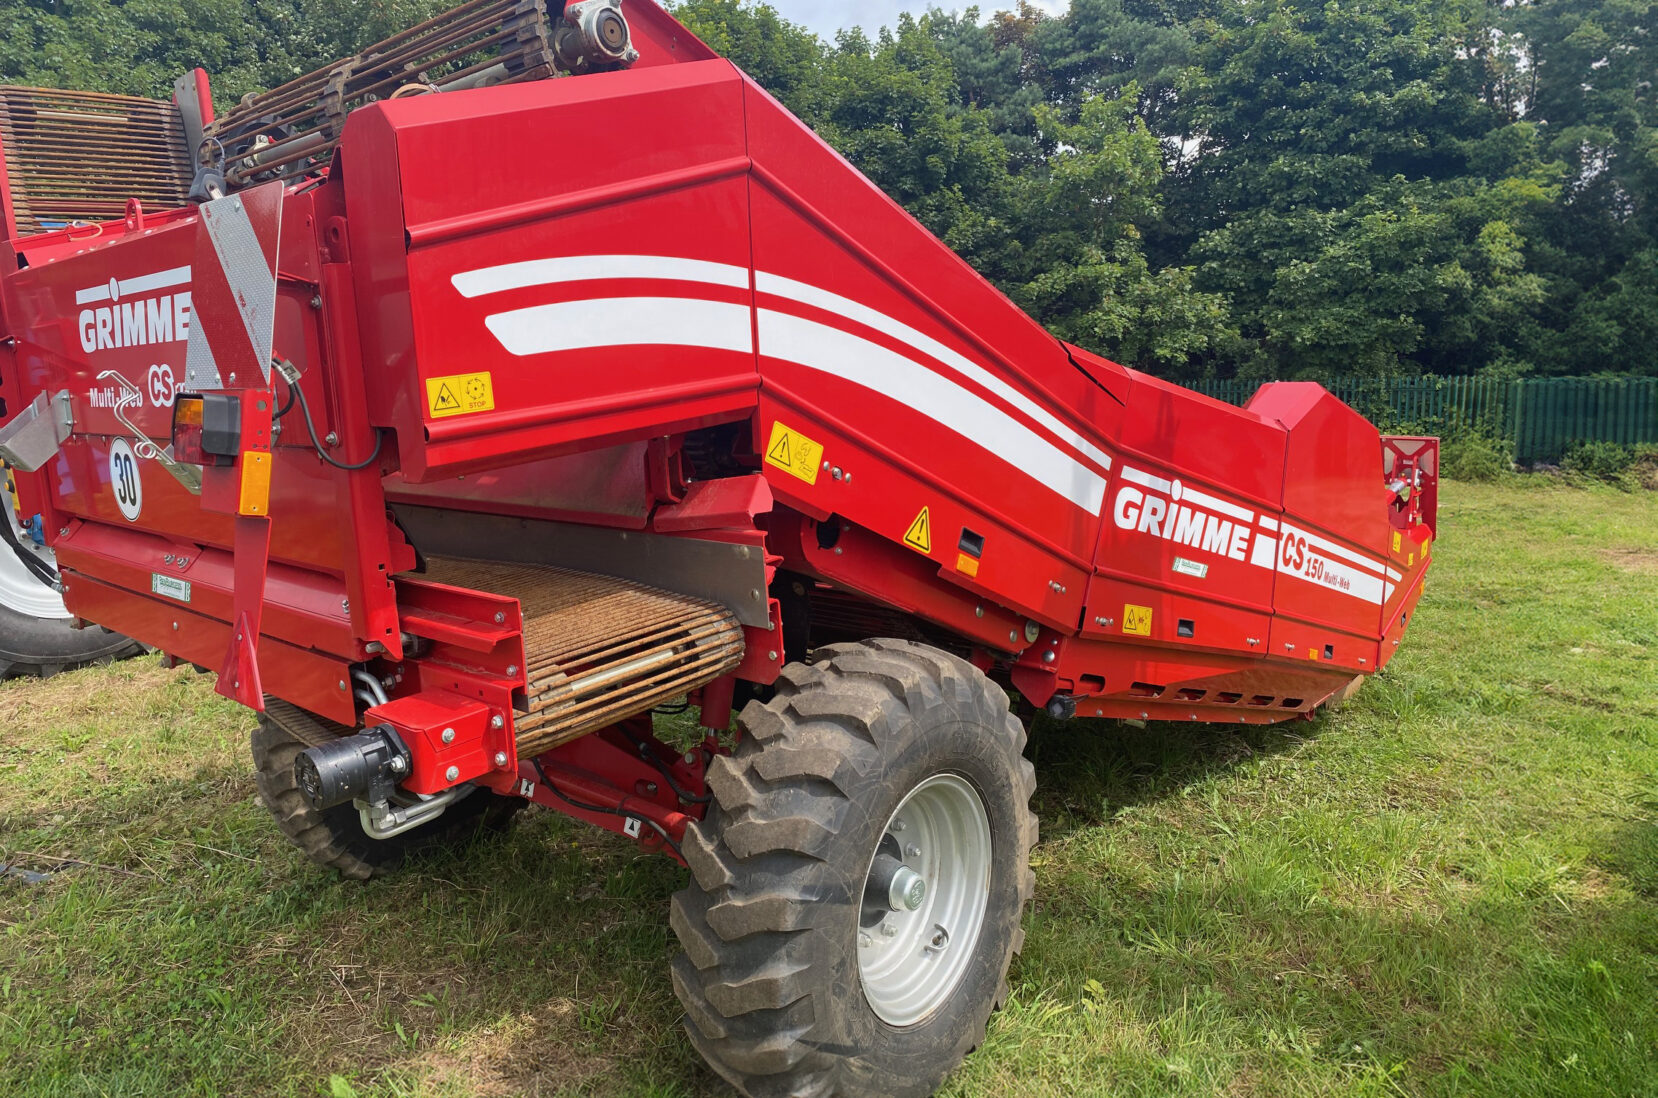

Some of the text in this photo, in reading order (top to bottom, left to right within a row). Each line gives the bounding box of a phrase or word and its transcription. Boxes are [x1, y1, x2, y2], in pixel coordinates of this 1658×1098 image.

[78, 278, 191, 353] GRIMME
[149, 364, 174, 407] CS
[469, 400, 486, 408] STOP
[115, 453, 137, 505] 30
[1114, 480, 1250, 561] GRIMME
[1282, 532, 1351, 591] CS 150 Multi-Web
